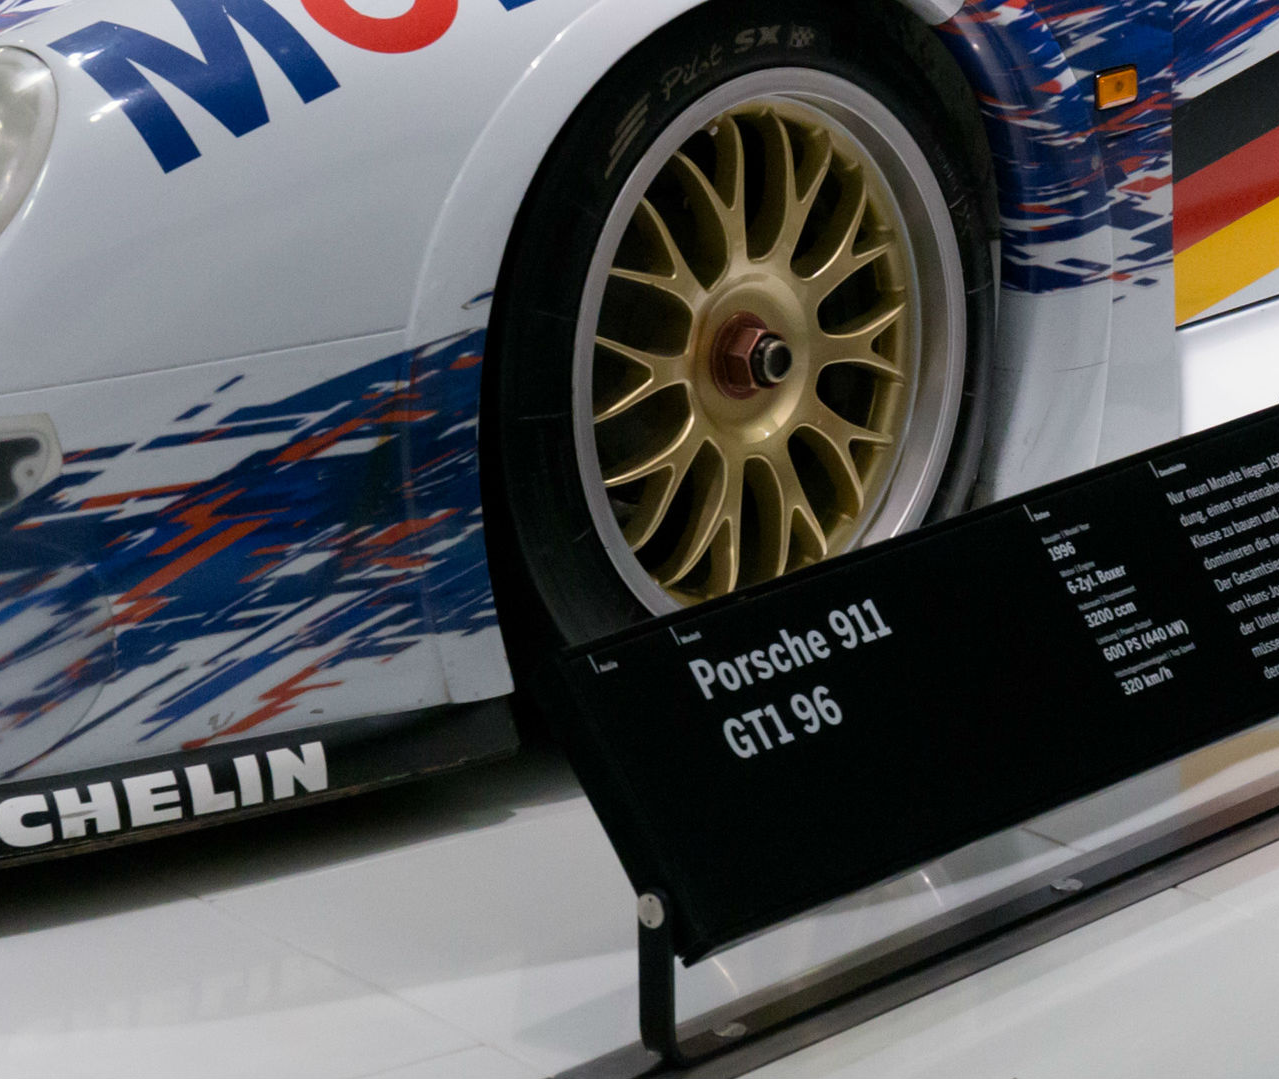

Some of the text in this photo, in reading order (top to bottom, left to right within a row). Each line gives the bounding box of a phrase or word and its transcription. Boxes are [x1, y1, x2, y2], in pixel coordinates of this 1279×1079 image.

[661, 24, 782, 101] Pilot SX
[1165, 491, 1186, 505] Nur
[1185, 483, 1210, 499] neun
[1206, 470, 1243, 491] Monate
[1240, 461, 1270, 479] liegen
[1179, 510, 1208, 527] dung,
[1206, 500, 1234, 517] einen
[1189, 530, 1223, 549] Klasse
[1221, 525, 1235, 538] zu
[1231, 515, 1263, 533] bauen
[1260, 506, 1279, 523] und
[1047, 541, 1076, 562] 1996
[1203, 544, 1256, 570] dominieren
[1254, 537, 1271, 551] die
[1066, 574, 1099, 595] 6-Zyl.
[1095, 565, 1126, 584] Boxer
[1213, 577, 1233, 592] Der
[1084, 601, 1137, 628] 3200 ccm
[1226, 599, 1246, 614] von
[1102, 642, 1127, 662] 600
[1124, 636, 1143, 654] PS
[1140, 627, 1168, 649] (440
[1165, 619, 1190, 638] kW)
[1239, 621, 1256, 636] der
[688, 598, 894, 700] Porsche 911
[1121, 666, 1174, 696] 320 km/h
[723, 685, 844, 759] GT1 96
